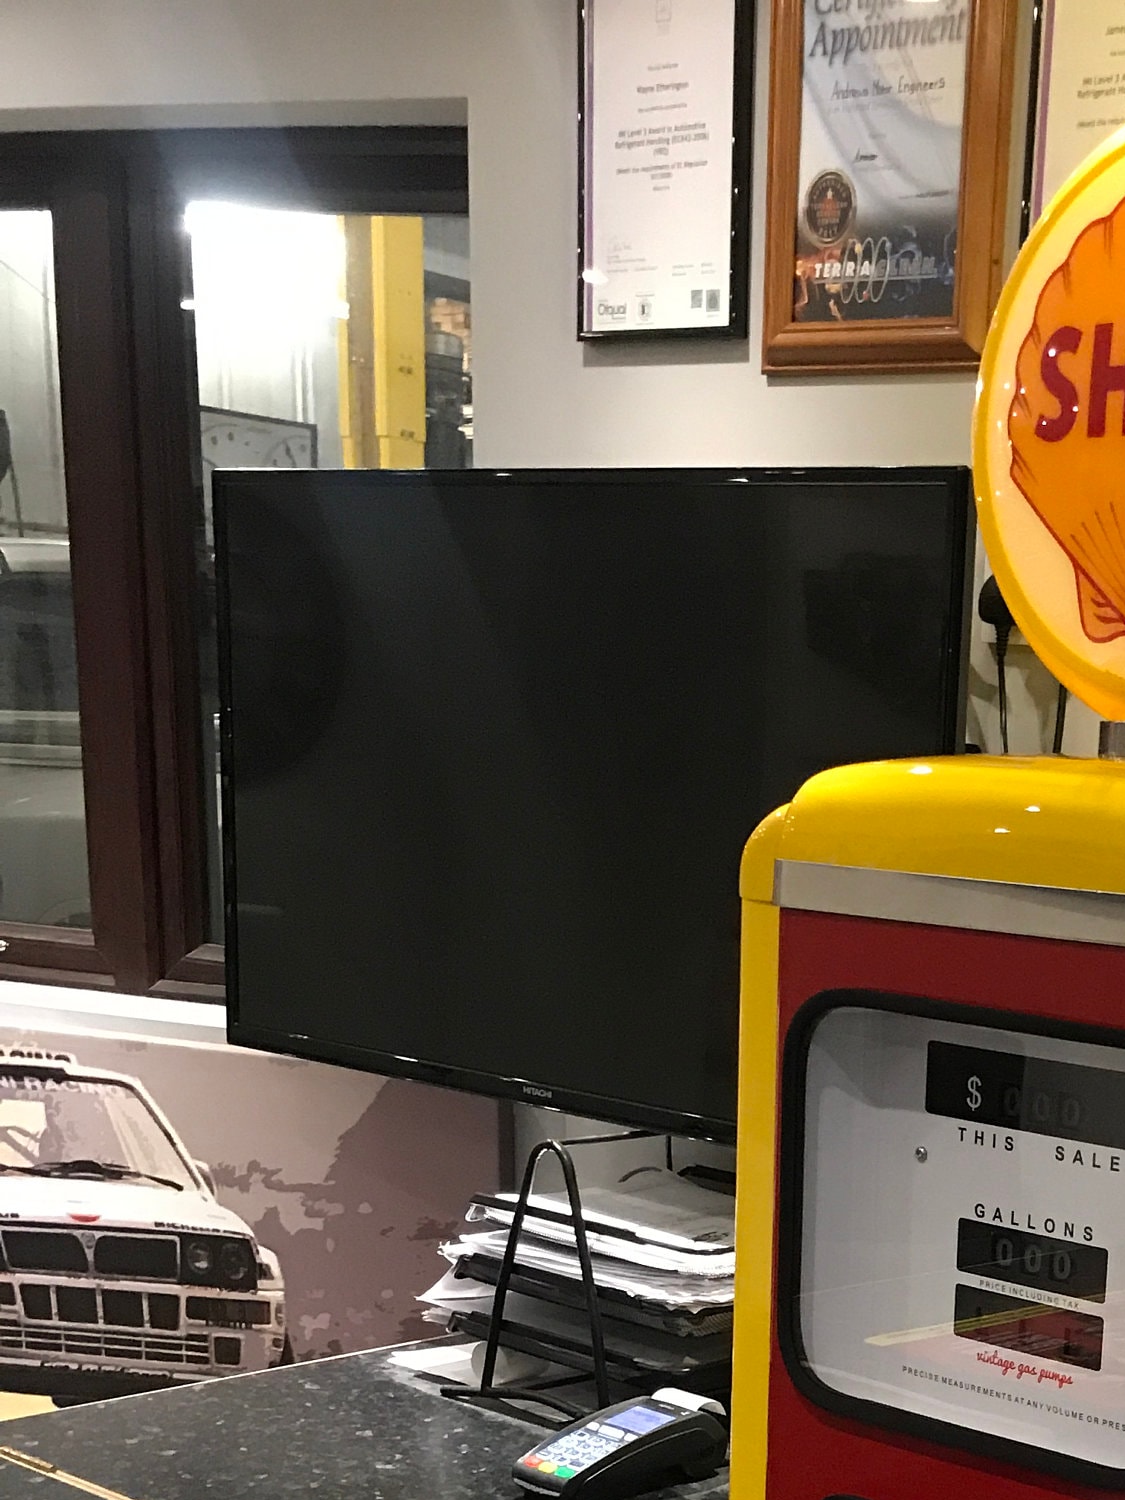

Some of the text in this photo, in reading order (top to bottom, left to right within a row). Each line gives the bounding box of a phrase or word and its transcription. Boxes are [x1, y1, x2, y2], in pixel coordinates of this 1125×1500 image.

[809, 9, 966, 66] Appointment
[522, 1085, 553, 1099] HITACHI
[966, 1075, 983, 1111] $
[958, 1126, 1121, 1172] THIS SALE
[974, 1203, 1094, 1242] GALLONS
[979, 1279, 1080, 1311] PRICE INCLUDING TAX
[976, 1350, 1074, 1389] vintage gas pumps
[902, 1365, 940, 1383] PRECISE
[941, 1376, 1013, 1402] MEASUREMENTS
[1013, 1395, 1025, 1405] AT
[1026, 1399, 1044, 1411] ANY
[1045, 1403, 1084, 1422] VOLUME
[1086, 1414, 1100, 1425] OR
